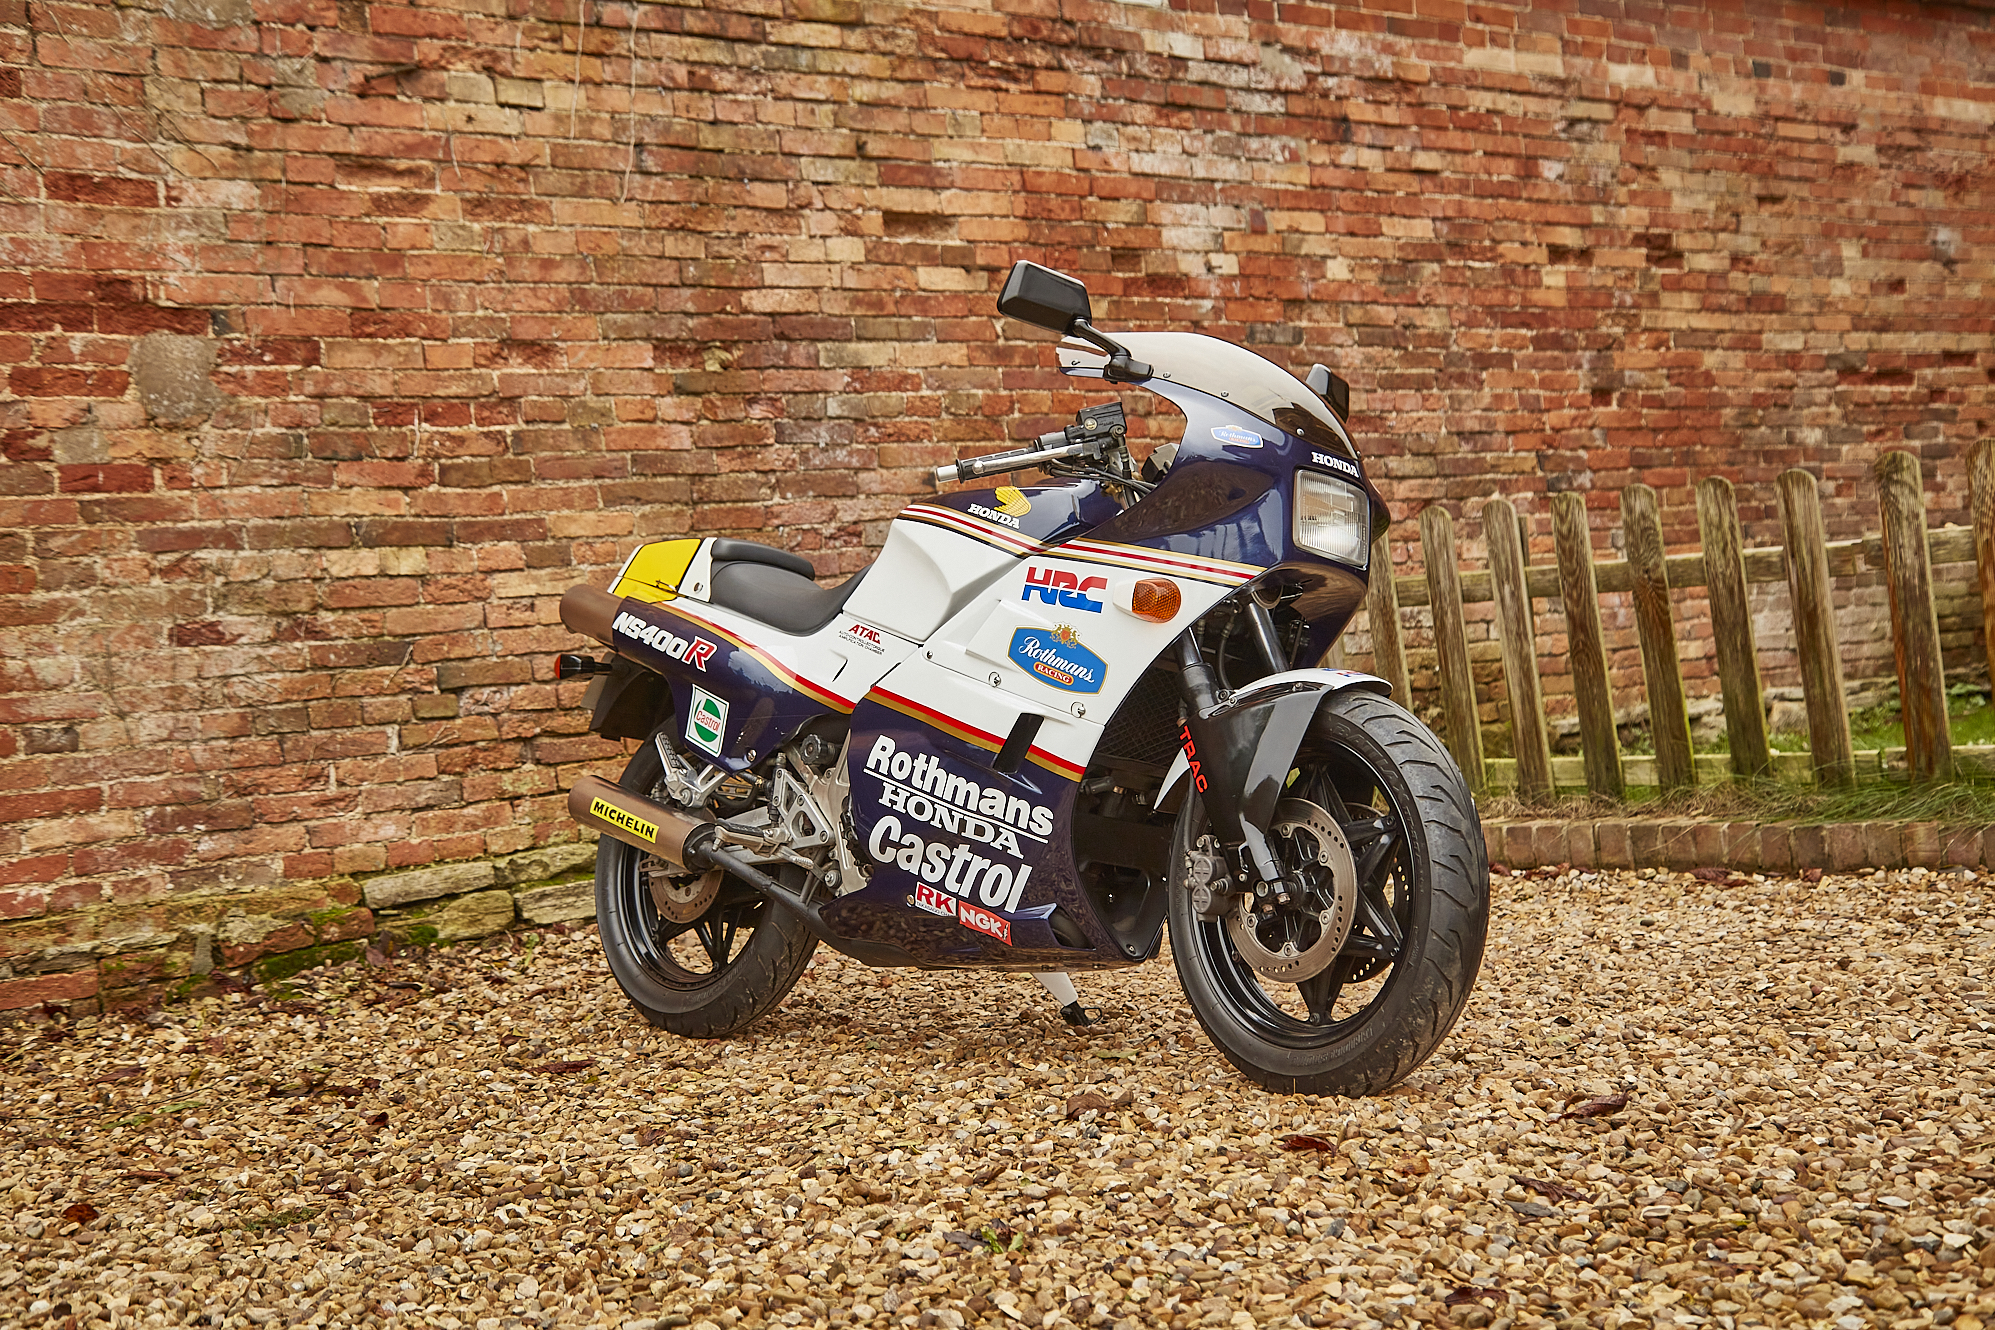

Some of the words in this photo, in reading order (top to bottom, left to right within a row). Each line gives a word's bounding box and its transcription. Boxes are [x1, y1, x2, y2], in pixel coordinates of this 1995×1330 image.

[1311, 452, 1359, 478] HONDA
[967, 503, 1020, 530] HONDA
[1021, 566, 1108, 614] HRC
[612, 611, 717, 672] NS400R
[848, 624, 881, 645] ATAC
[1018, 636, 1095, 683] Rothmans
[1036, 663, 1071, 684] RACING
[695, 709, 722, 732] Castrol
[1178, 725, 1208, 794] TRAC
[866, 734, 1054, 836] Rothmans
[593, 800, 656, 840] MICHELIN
[878, 782, 1024, 859] HONDA
[868, 815, 1033, 914] Castrol
[916, 883, 954, 915] RK
[960, 905, 1003, 938] NGK
